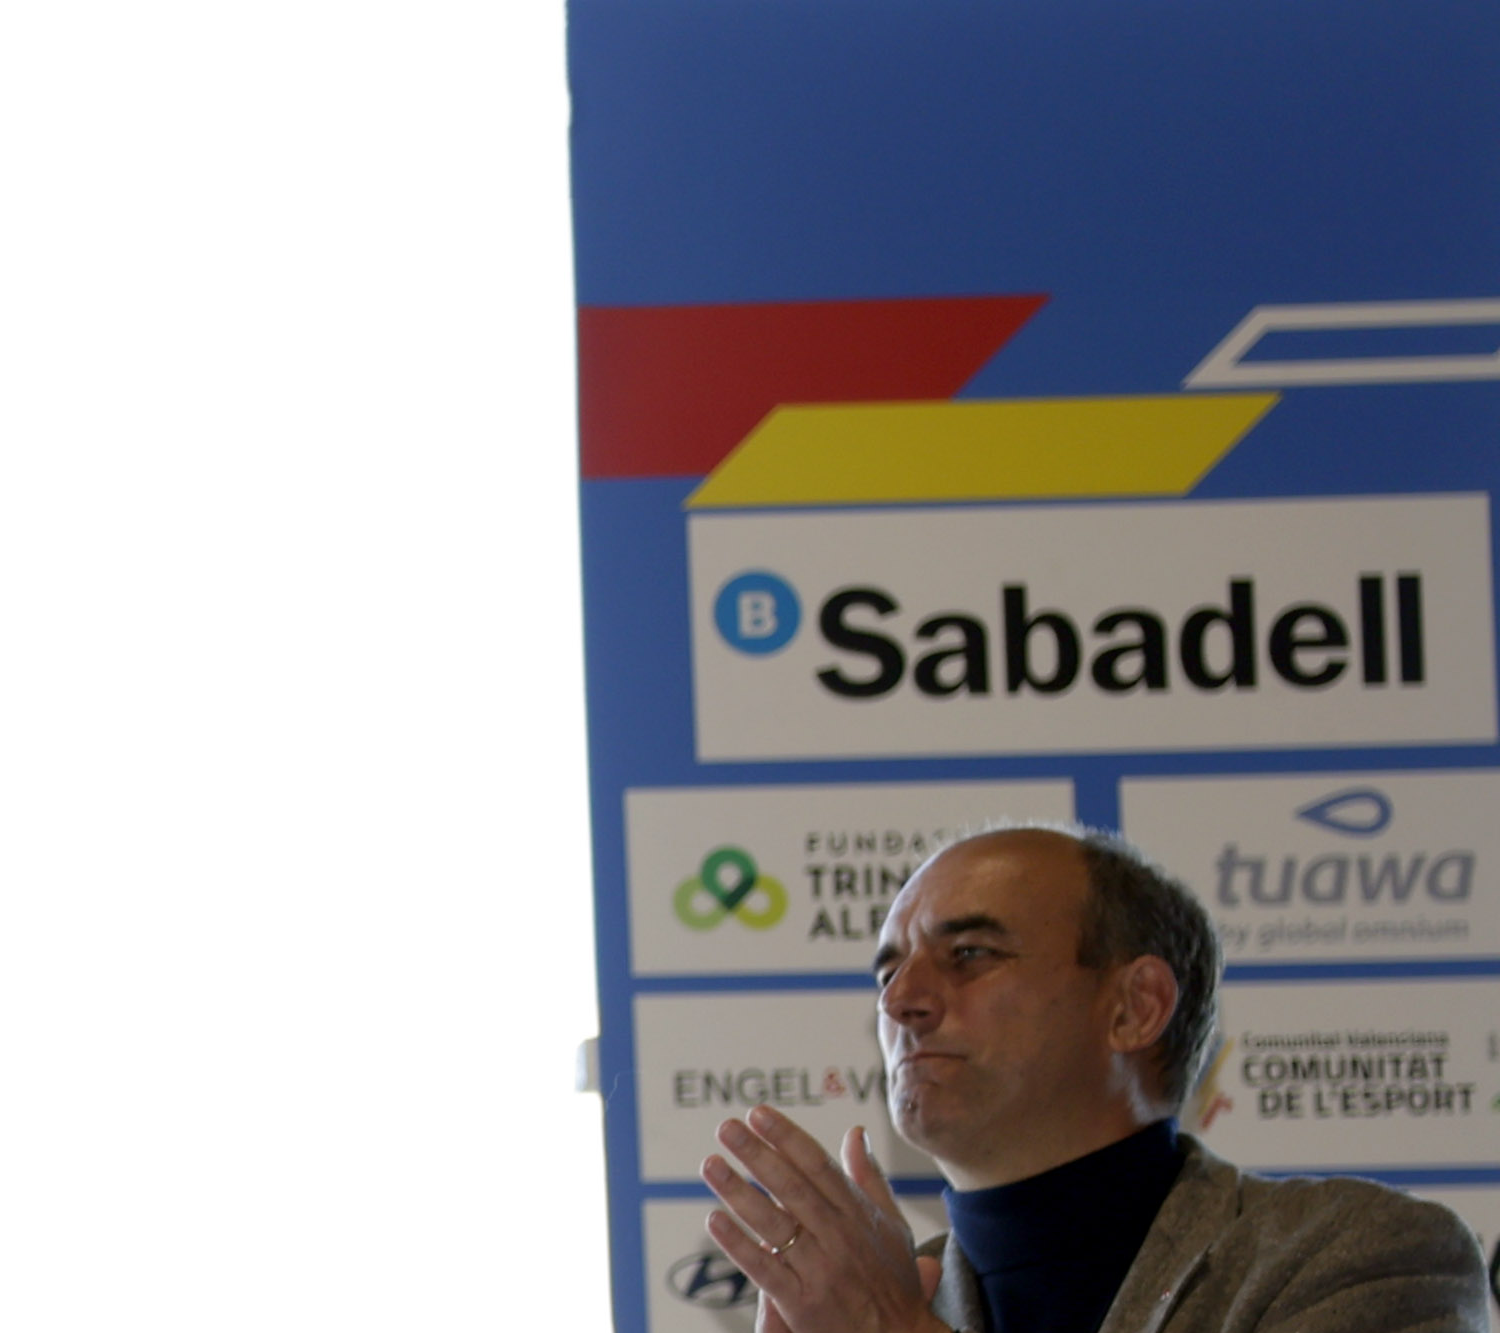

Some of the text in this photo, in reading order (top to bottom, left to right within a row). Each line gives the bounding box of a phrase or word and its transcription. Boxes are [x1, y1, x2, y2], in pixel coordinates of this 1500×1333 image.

[815, 569, 1427, 702] Sabadell
[1216, 844, 1476, 907] tuawa
[1242, 1053, 1449, 1085] COMUNITAT
[1259, 1087, 1303, 1118] DE
